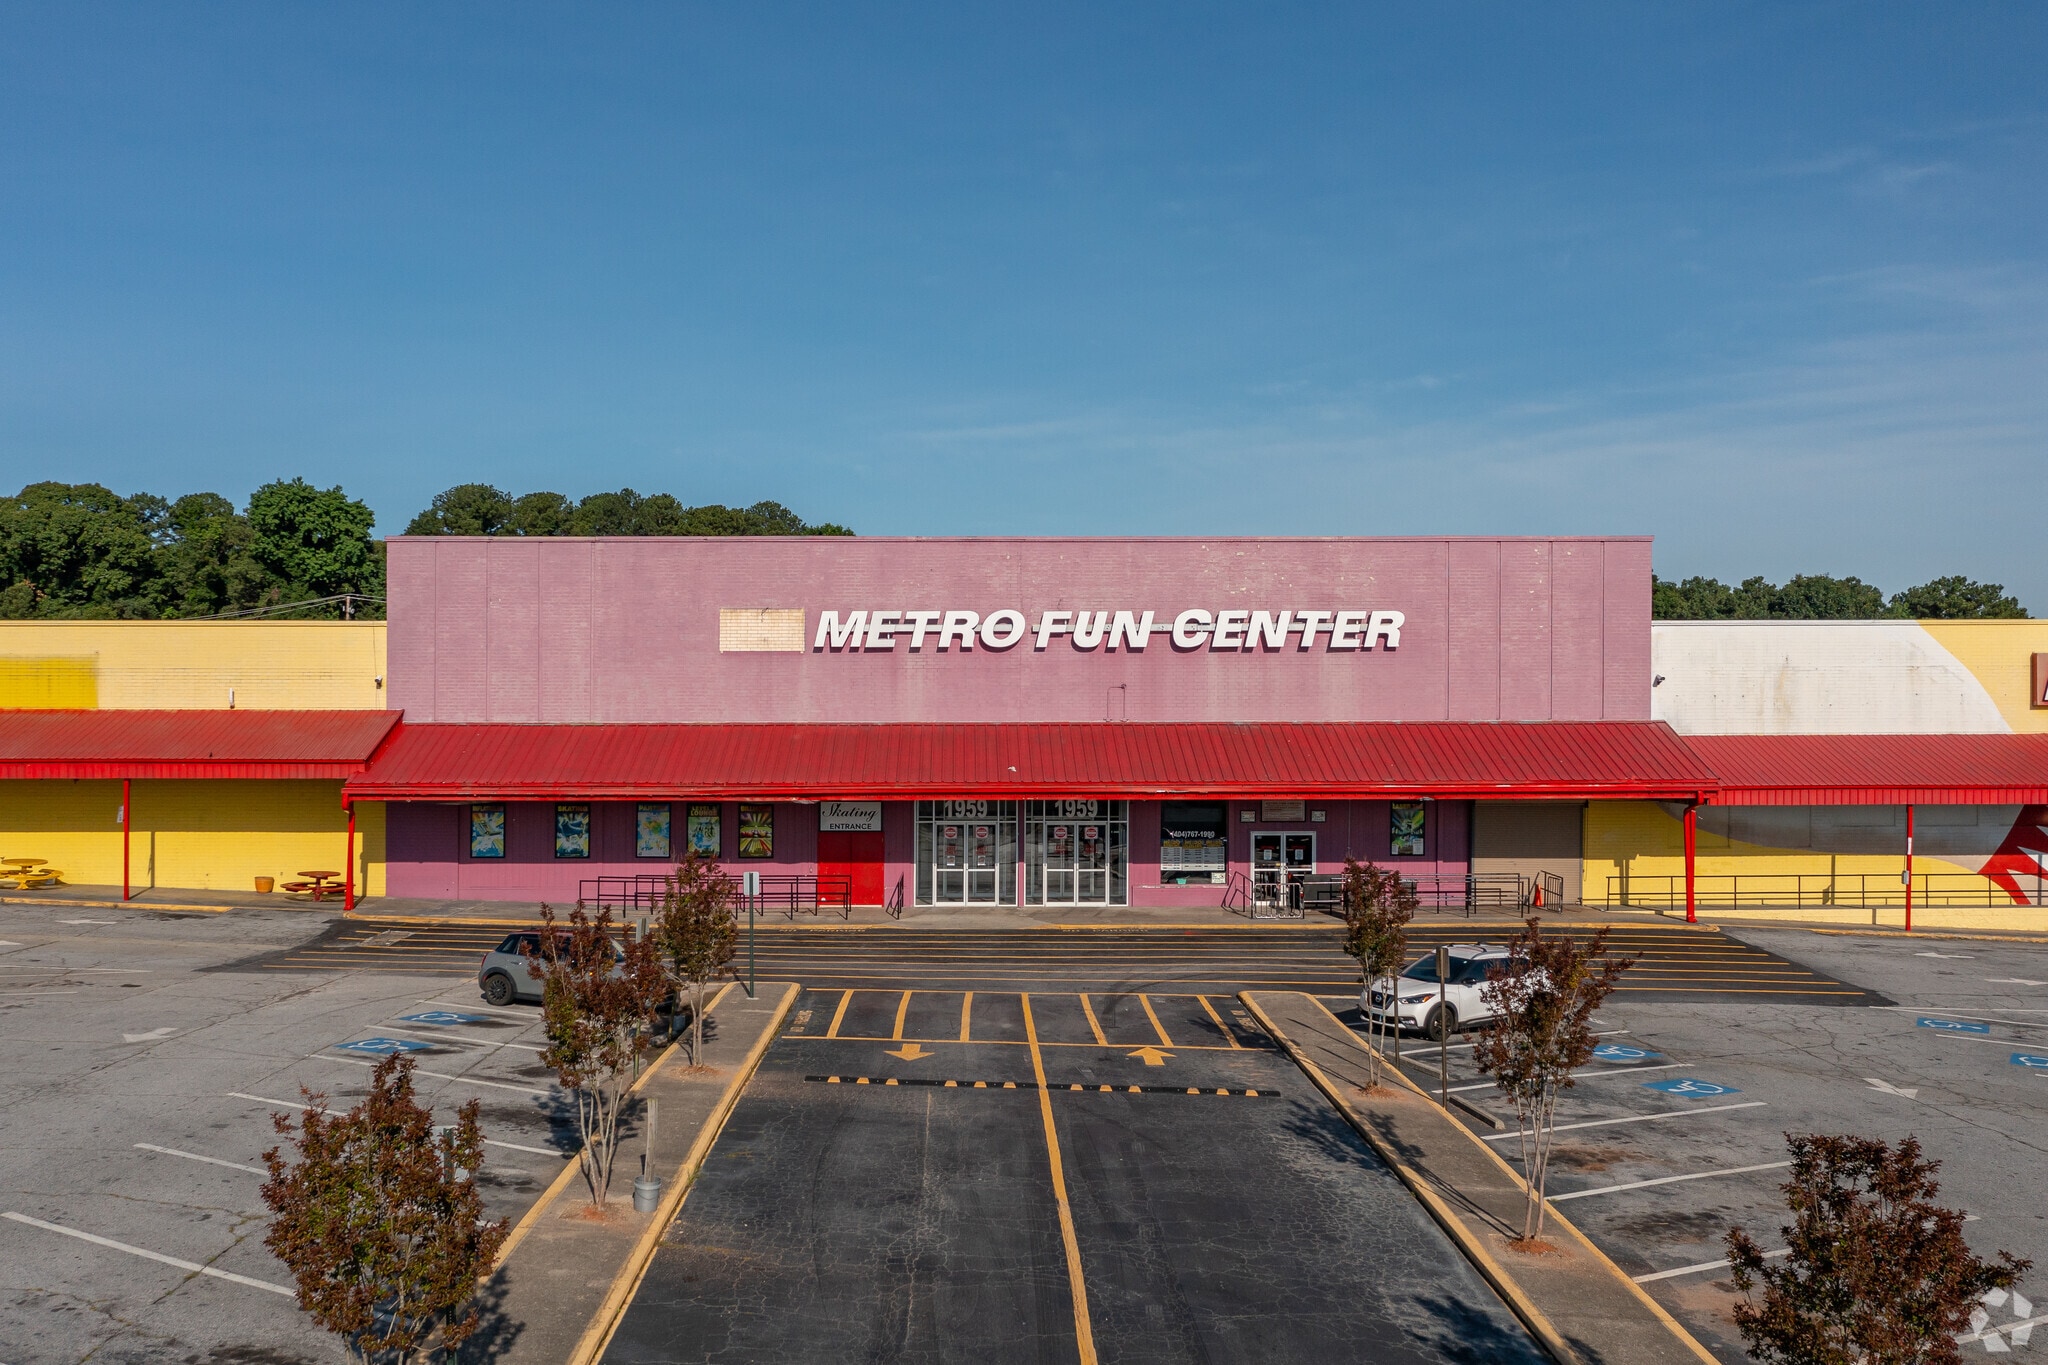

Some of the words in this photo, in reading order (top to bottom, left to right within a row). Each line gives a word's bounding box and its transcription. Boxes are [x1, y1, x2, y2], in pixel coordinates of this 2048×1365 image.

[813, 609, 1026, 649] METRO
[1035, 610, 1155, 649] FUN
[1172, 608, 1406, 649] CENTER
[822, 802, 879, 822] Skating
[944, 799, 988, 818] 1959
[1054, 799, 1098, 818] 1959
